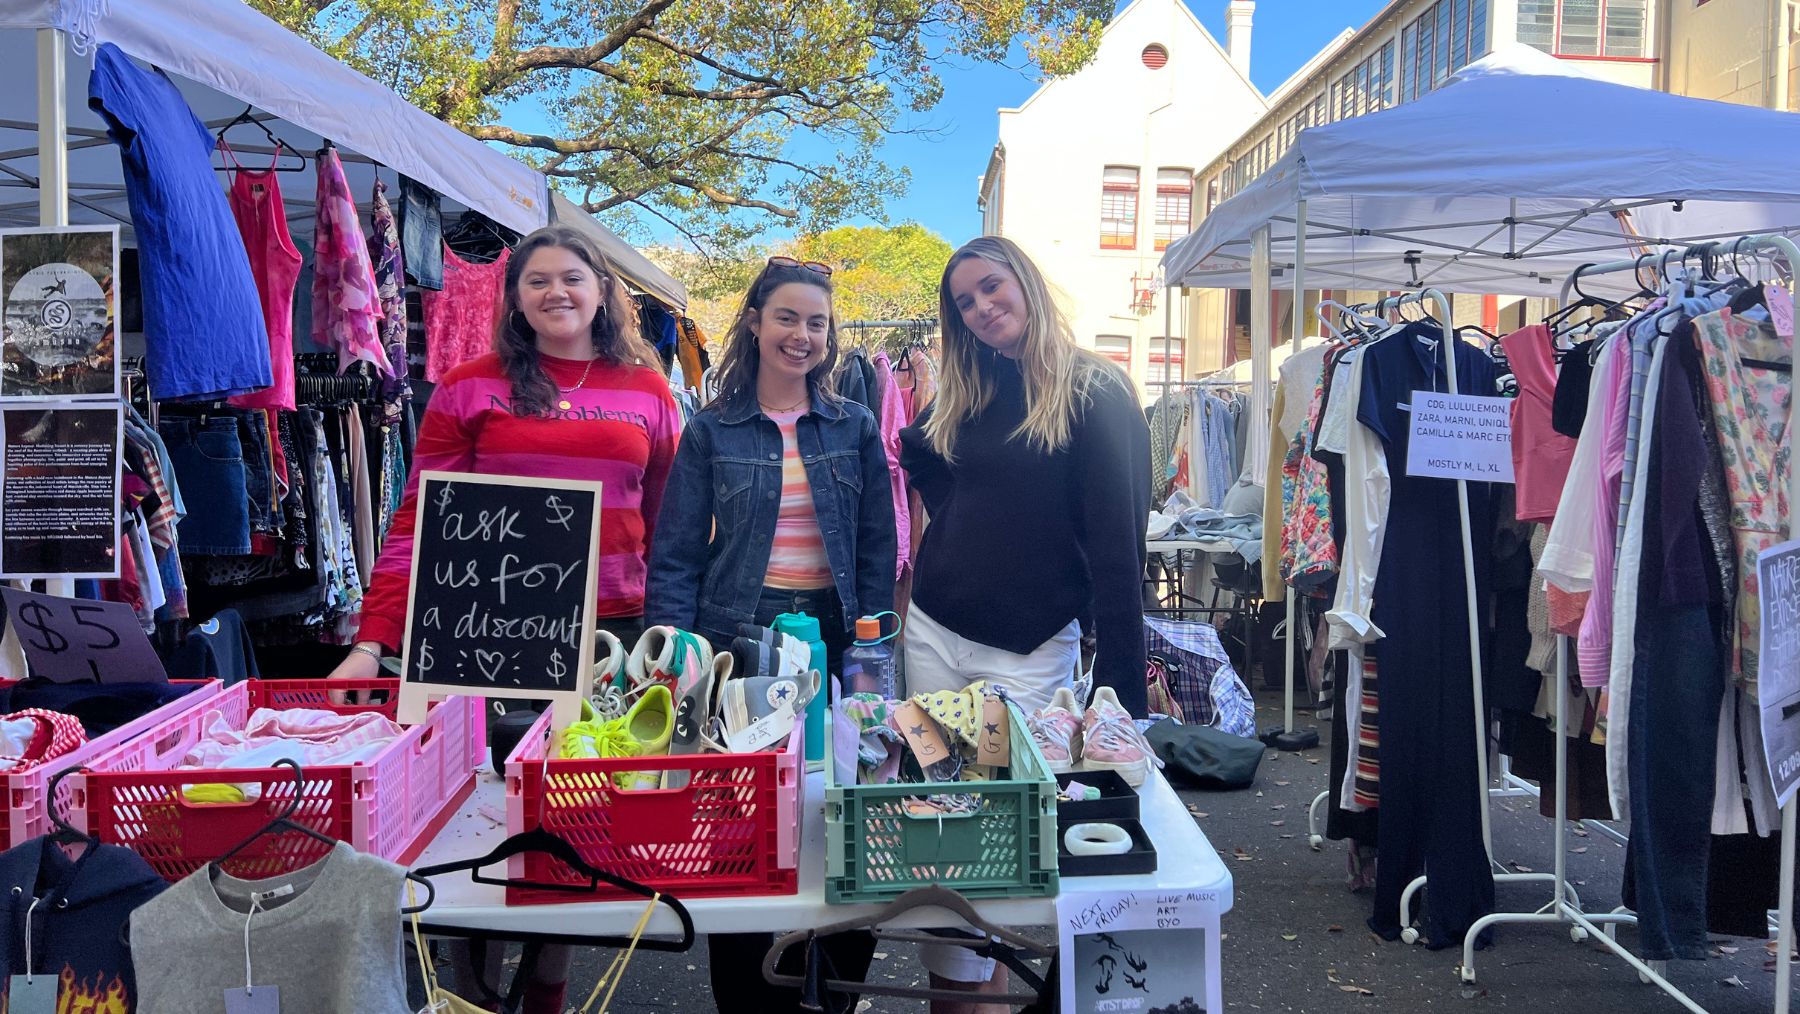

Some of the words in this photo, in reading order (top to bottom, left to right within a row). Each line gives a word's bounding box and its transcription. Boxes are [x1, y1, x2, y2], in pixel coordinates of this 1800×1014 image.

[1428, 400, 1446, 410] CDG,
[1449, 402, 1508, 415] LULULEMON,
[1418, 413, 1442, 424] ZARA,
[1444, 416, 1476, 427] MARNI,
[1479, 418, 1510, 429] UNIQL
[1417, 428, 1454, 439] CAMILLA
[1457, 431, 1463, 439] &
[1466, 432, 1493, 441] MARC
[1428, 459, 1462, 469] MOSTLY
[1488, 464, 1500, 473] XL
[442, 506, 526, 543] ask
[434, 559, 480, 588] us
[491, 554, 583, 605] for
[423, 606, 441, 630] a
[454, 601, 582, 649] discount
[1156, 895, 1183, 904] LIVE
[1186, 893, 1216, 902] MUSIC
[1070, 898, 1102, 931] NEXT
[1095, 892, 1138, 929] FRIDAY!
[1157, 906, 1178, 916] ART
[1157, 917, 1181, 928] BYO
